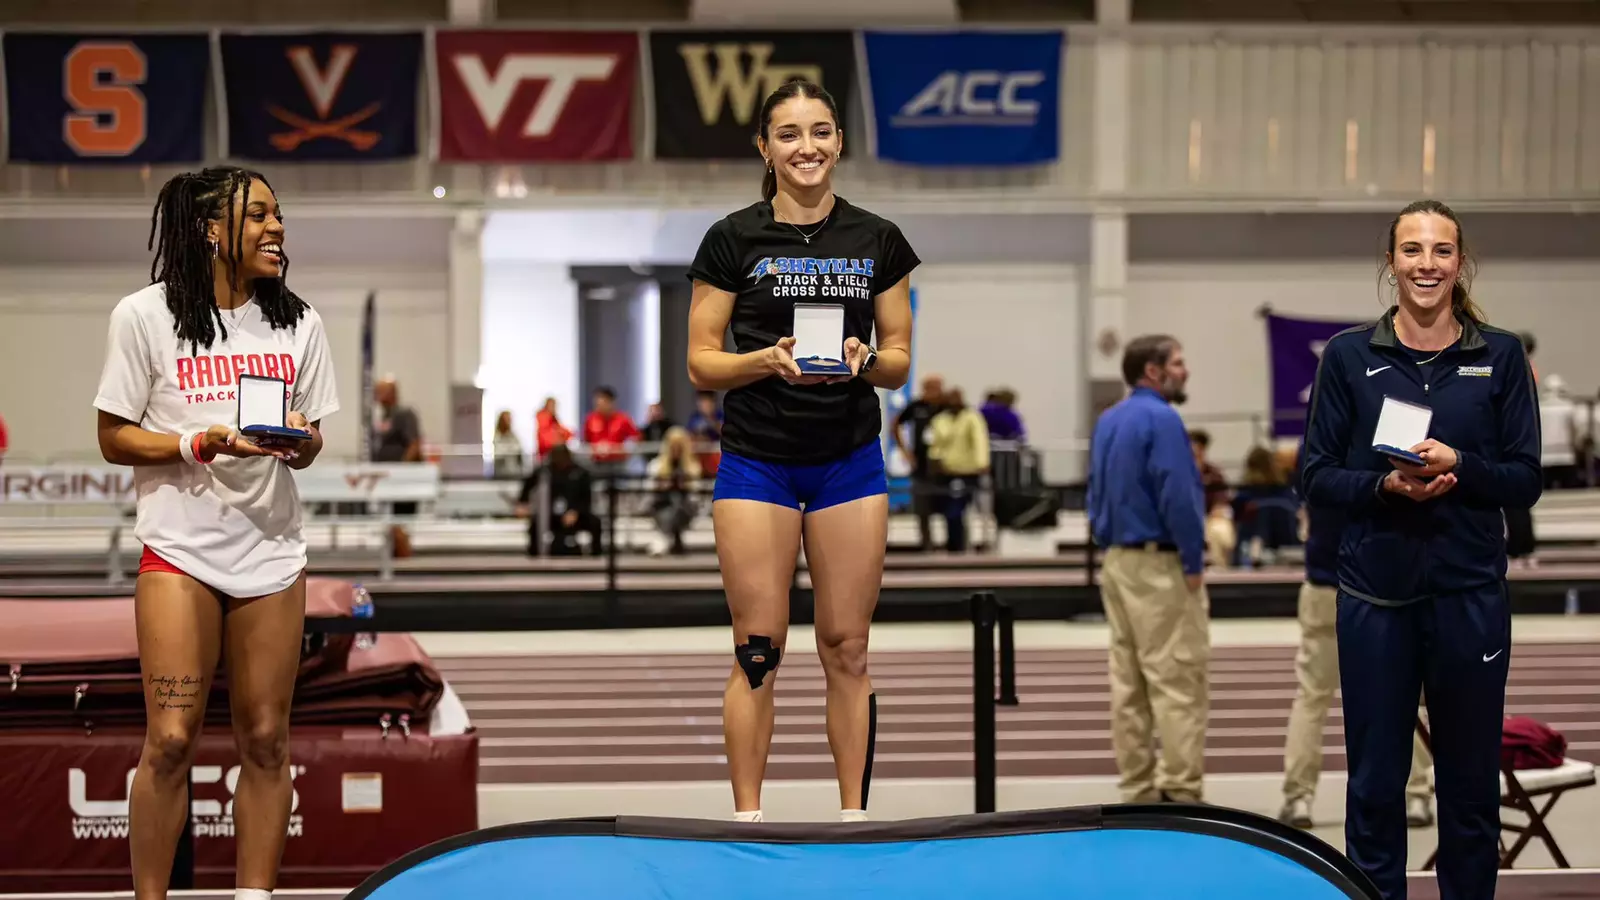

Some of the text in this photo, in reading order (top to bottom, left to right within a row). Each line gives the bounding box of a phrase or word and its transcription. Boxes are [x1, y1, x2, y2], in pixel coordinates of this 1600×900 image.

[63, 40, 147, 157] S
[286, 44, 358, 119] V
[452, 52, 620, 137] VT
[901, 71, 1045, 115] ACC
[747, 257, 875, 284] ASHEVILLE
[776, 275, 868, 288] TRACK & FIELD
[773, 286, 871, 300] CROSS COUNTRY
[176, 353, 296, 390] RADFORD
[185, 391, 237, 404] TRACK
